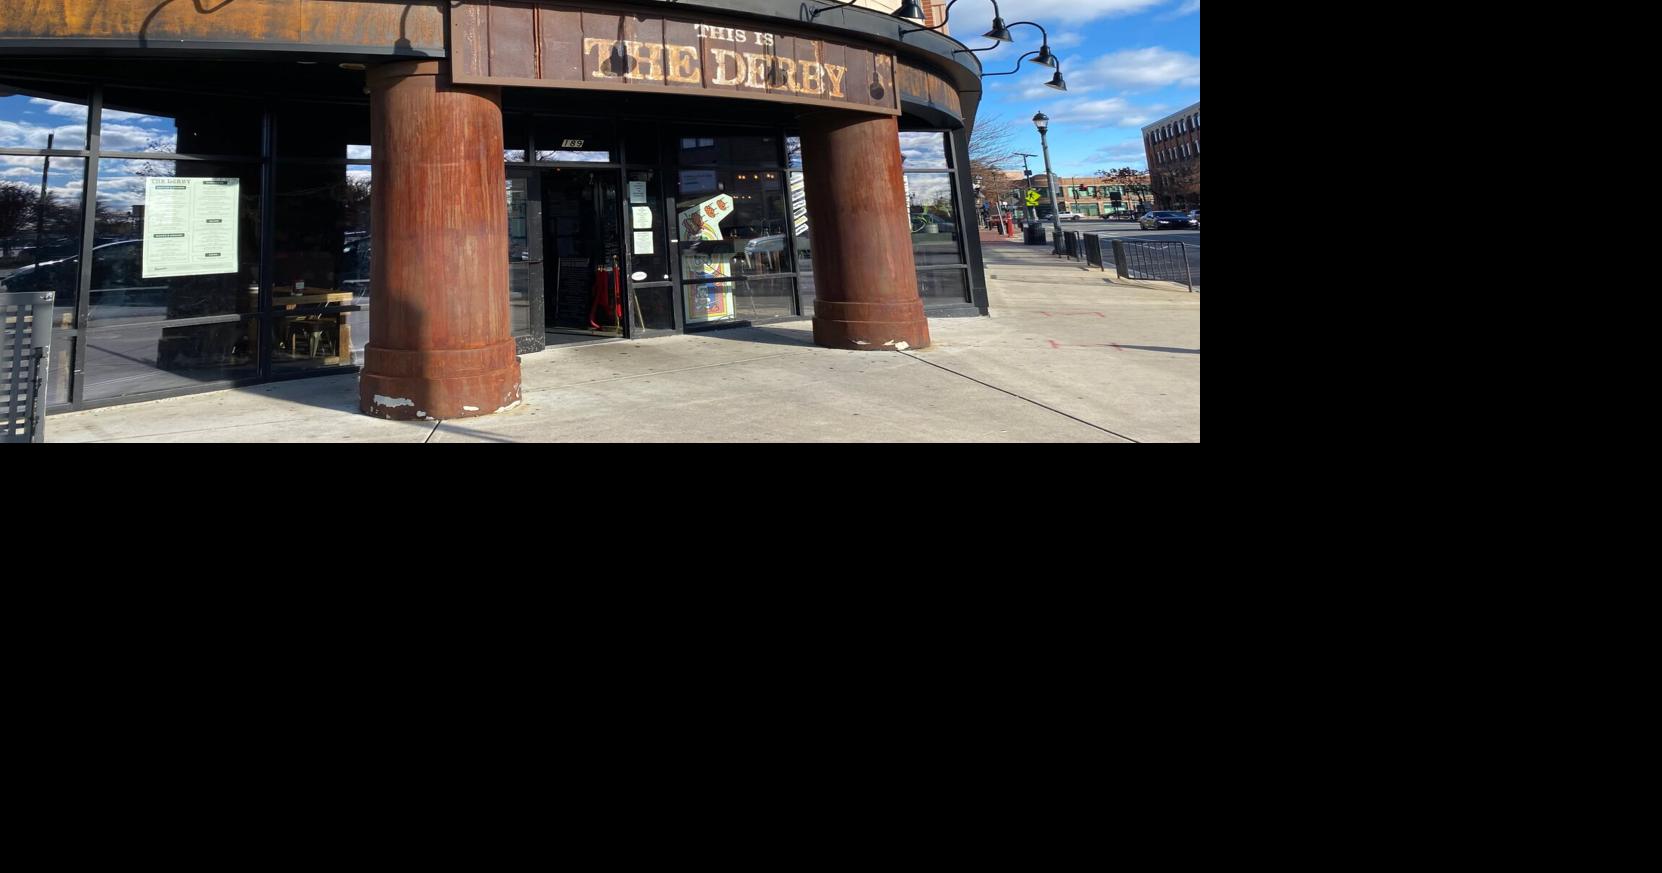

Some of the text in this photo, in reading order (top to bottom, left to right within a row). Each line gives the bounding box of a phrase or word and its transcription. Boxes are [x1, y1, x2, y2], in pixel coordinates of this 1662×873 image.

[694, 23, 775, 46] THIS IS
[583, 37, 848, 98] THE DERBY
[562, 139, 584, 148] 189
